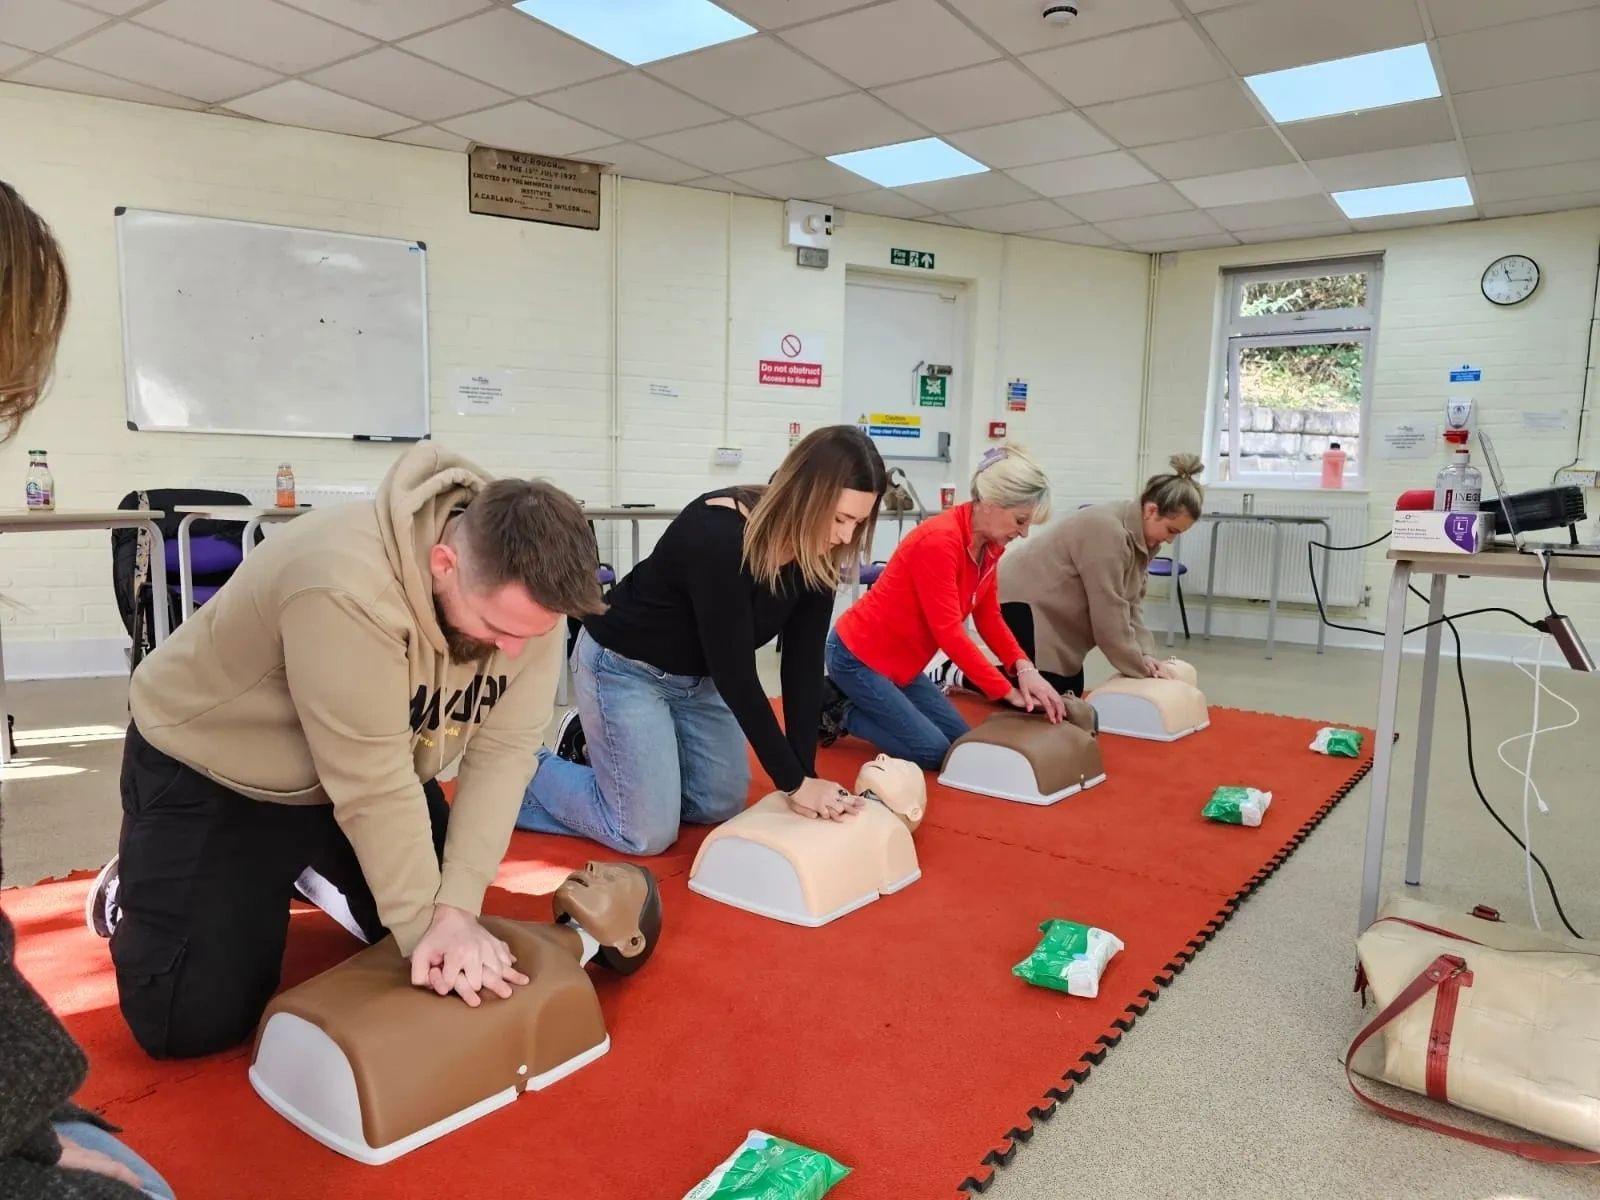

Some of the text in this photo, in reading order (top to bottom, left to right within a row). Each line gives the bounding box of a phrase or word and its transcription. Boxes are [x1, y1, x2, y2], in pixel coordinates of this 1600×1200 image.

[510, 165, 522, 173] THE
[540, 170, 559, 178] JULY
[893, 250, 906, 258] Fire
[761, 363, 820, 375] Do not obstruct
[762, 374, 787, 383] Access
[1457, 522, 1464, 530] L
